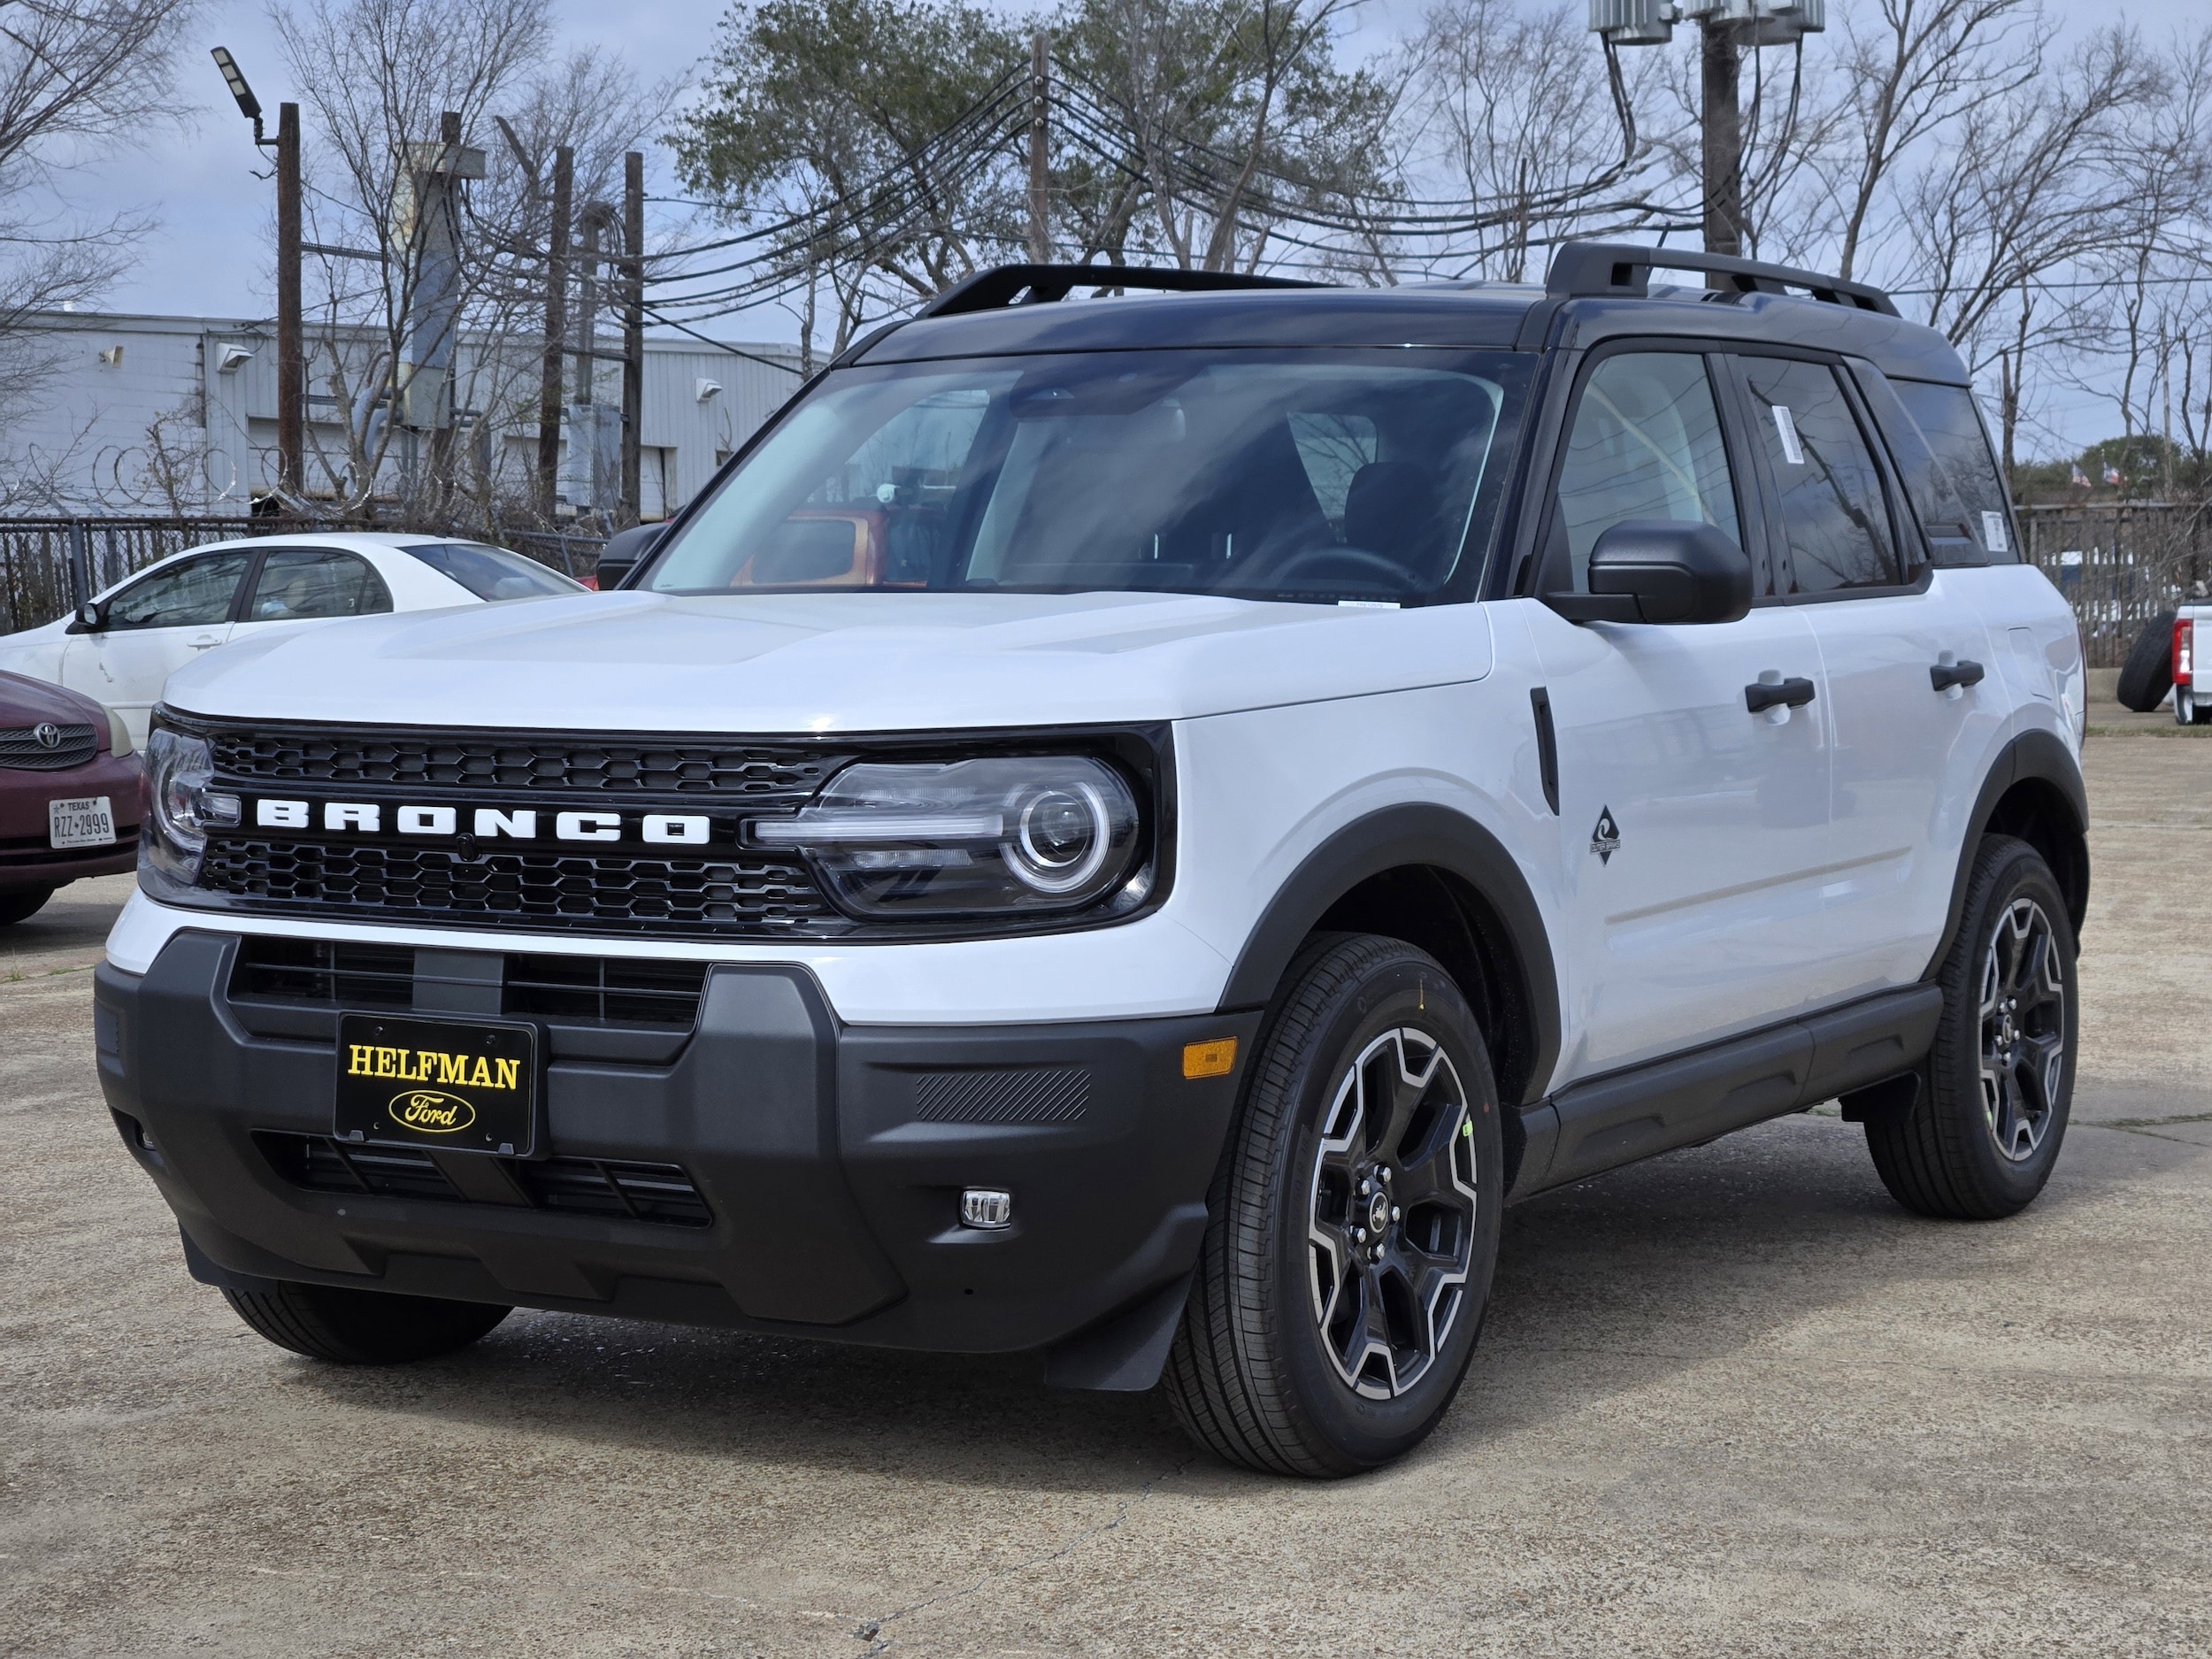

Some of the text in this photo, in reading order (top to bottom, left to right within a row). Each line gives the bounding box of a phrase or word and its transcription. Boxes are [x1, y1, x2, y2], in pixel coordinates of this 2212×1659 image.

[68, 802, 89, 811] TEXAS
[257, 799, 710, 844] BRONCO
[54, 812, 110, 838] RZZ 2999
[348, 1045, 520, 1089] HELFMAN
[404, 1094, 458, 1125] Ford
